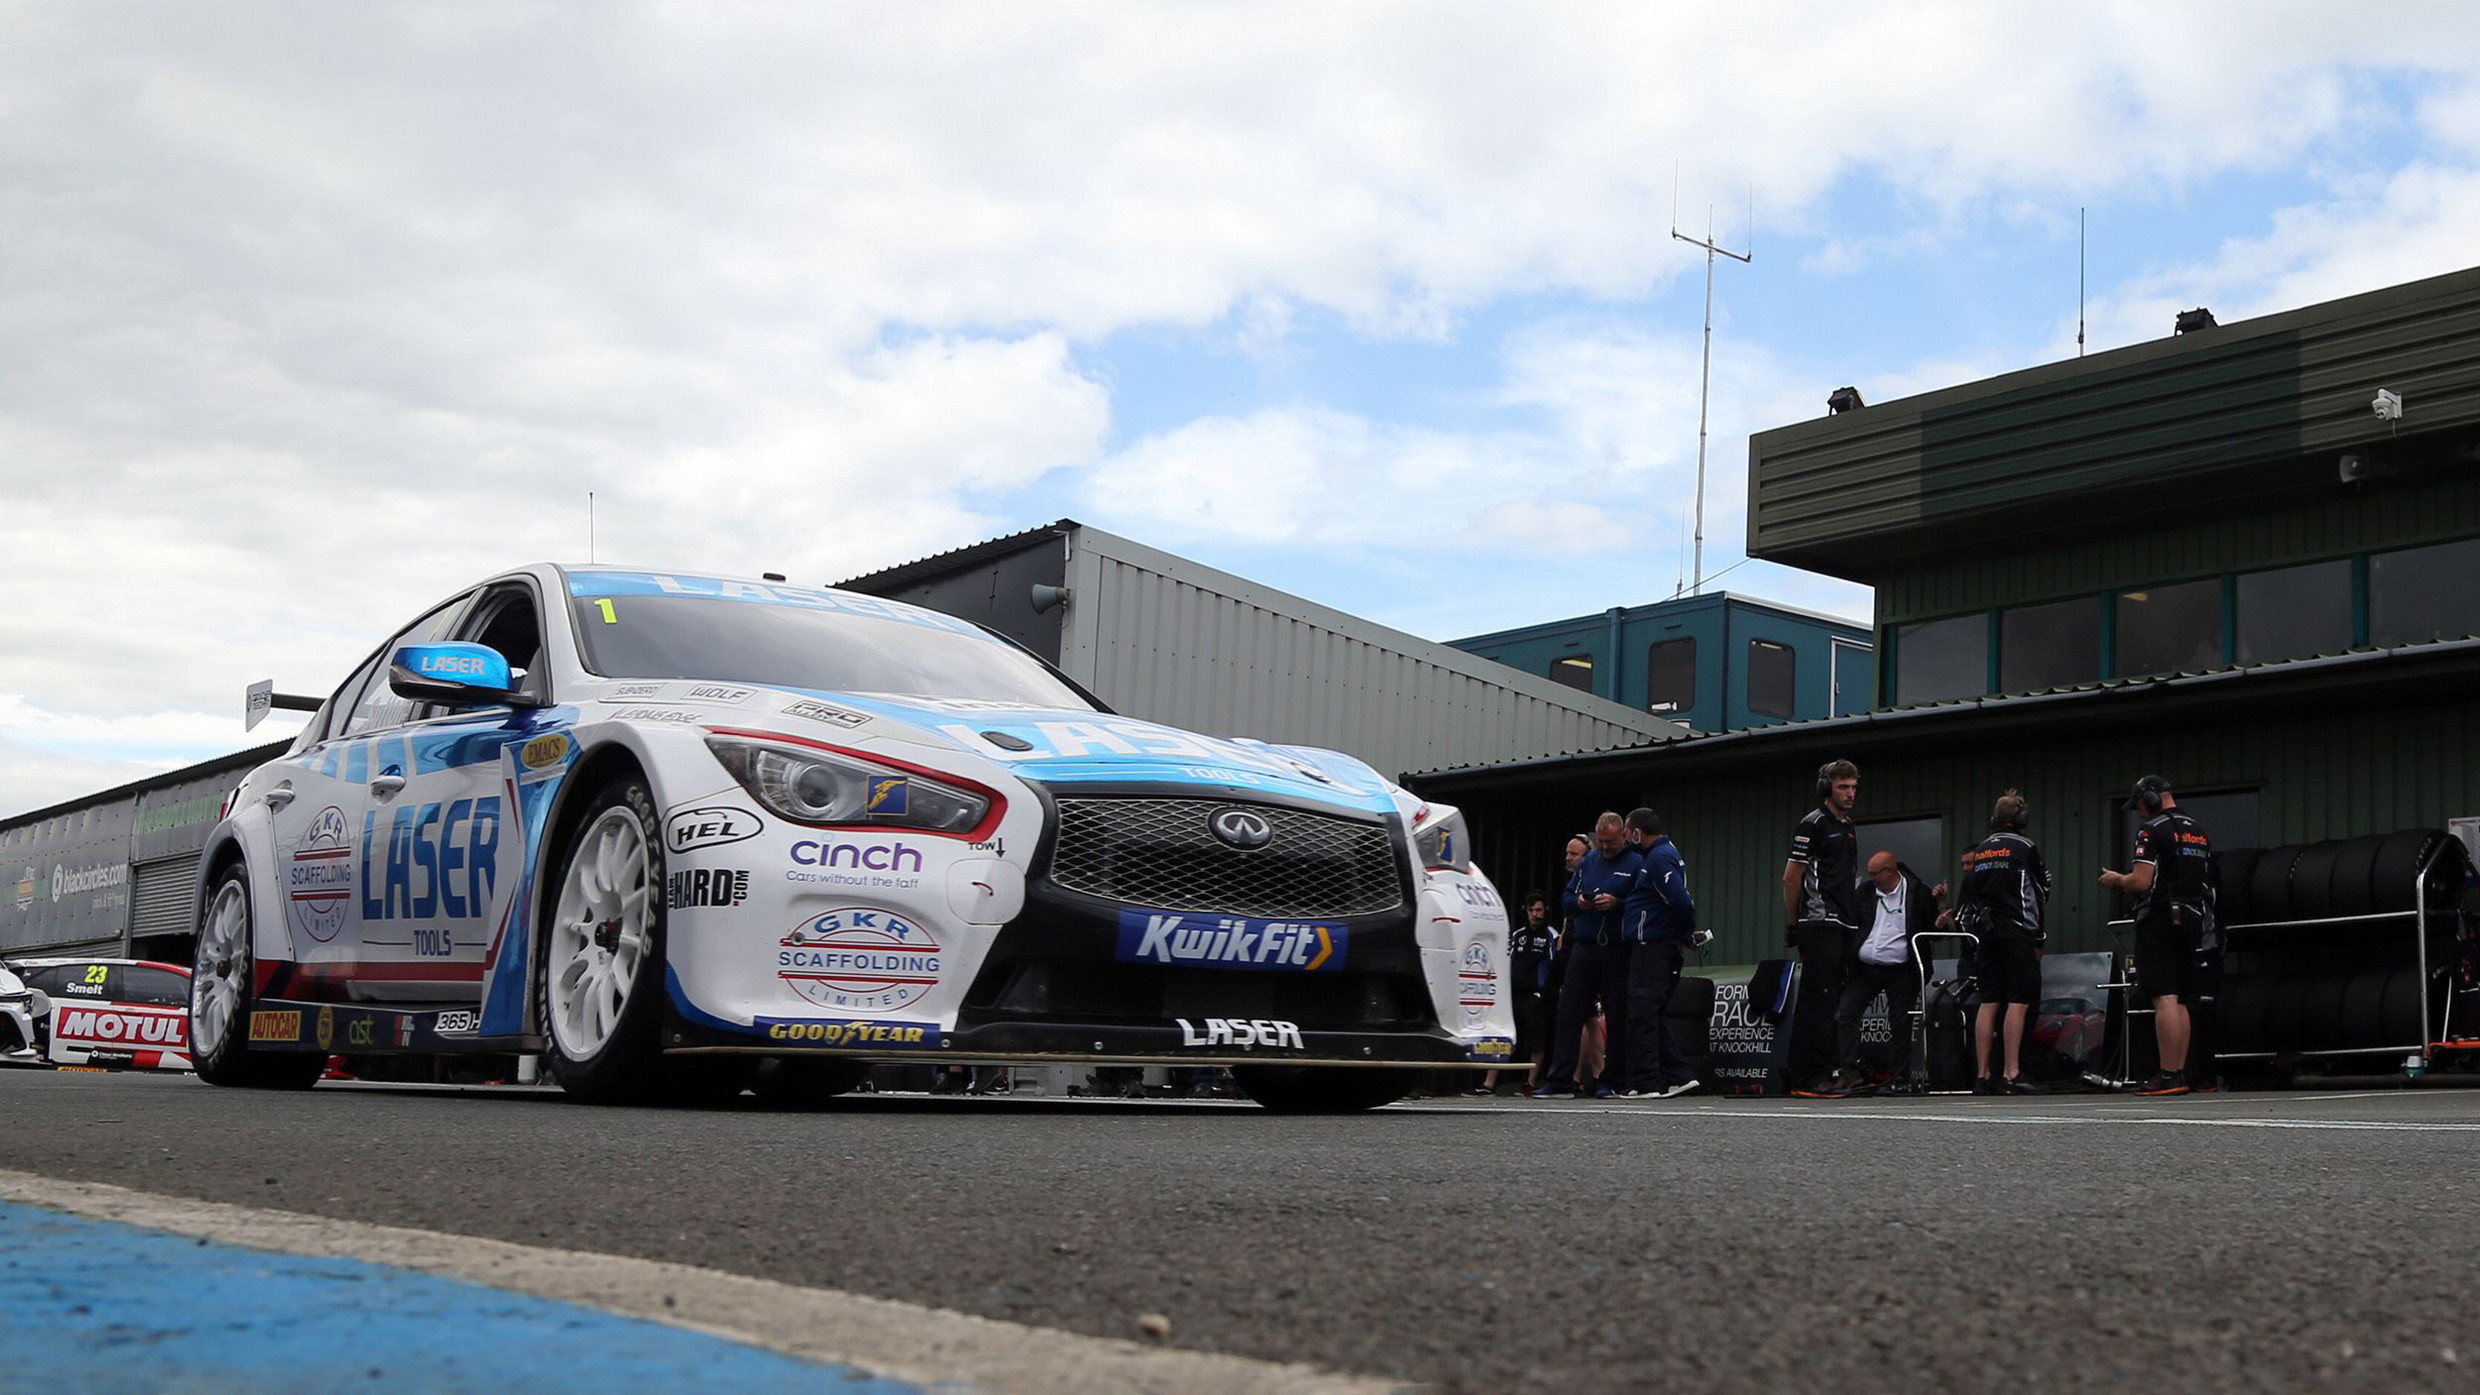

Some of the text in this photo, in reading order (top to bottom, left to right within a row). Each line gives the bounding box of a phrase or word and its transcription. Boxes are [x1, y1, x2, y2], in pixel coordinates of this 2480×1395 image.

[595, 598, 618, 624] 1
[421, 656, 486, 675] LASER
[690, 687, 747, 700] WOLF
[1177, 767, 1261, 785] TOOLS
[309, 812, 343, 843] GKR
[677, 821, 741, 846] HEL
[360, 795, 501, 920] LASER
[790, 832, 923, 873] cinch
[968, 841, 996, 851] TOW
[291, 864, 351, 886] SCAFFOLDING
[786, 870, 920, 889] Cars without the faff
[674, 869, 734, 910] HARD
[814, 912, 910, 940] GKR
[414, 930, 452, 956] TOOLS
[778, 951, 940, 972] SCAFFOLDING
[84, 965, 109, 984] 23
[66, 982, 104, 995] Smelt
[808, 984, 910, 1008] LIMITED
[62, 1011, 183, 1043] MOTUL
[251, 1013, 298, 1039] AUTOCAR
[769, 1021, 925, 1044] GOODYEAR
[1175, 1018, 1305, 1049] LASER
[1709, 1027, 1774, 1040] EXPERIENCE
[1719, 1042, 1772, 1053] KNOCKHILL
[1726, 1068, 1768, 1078] AVAILABLE
